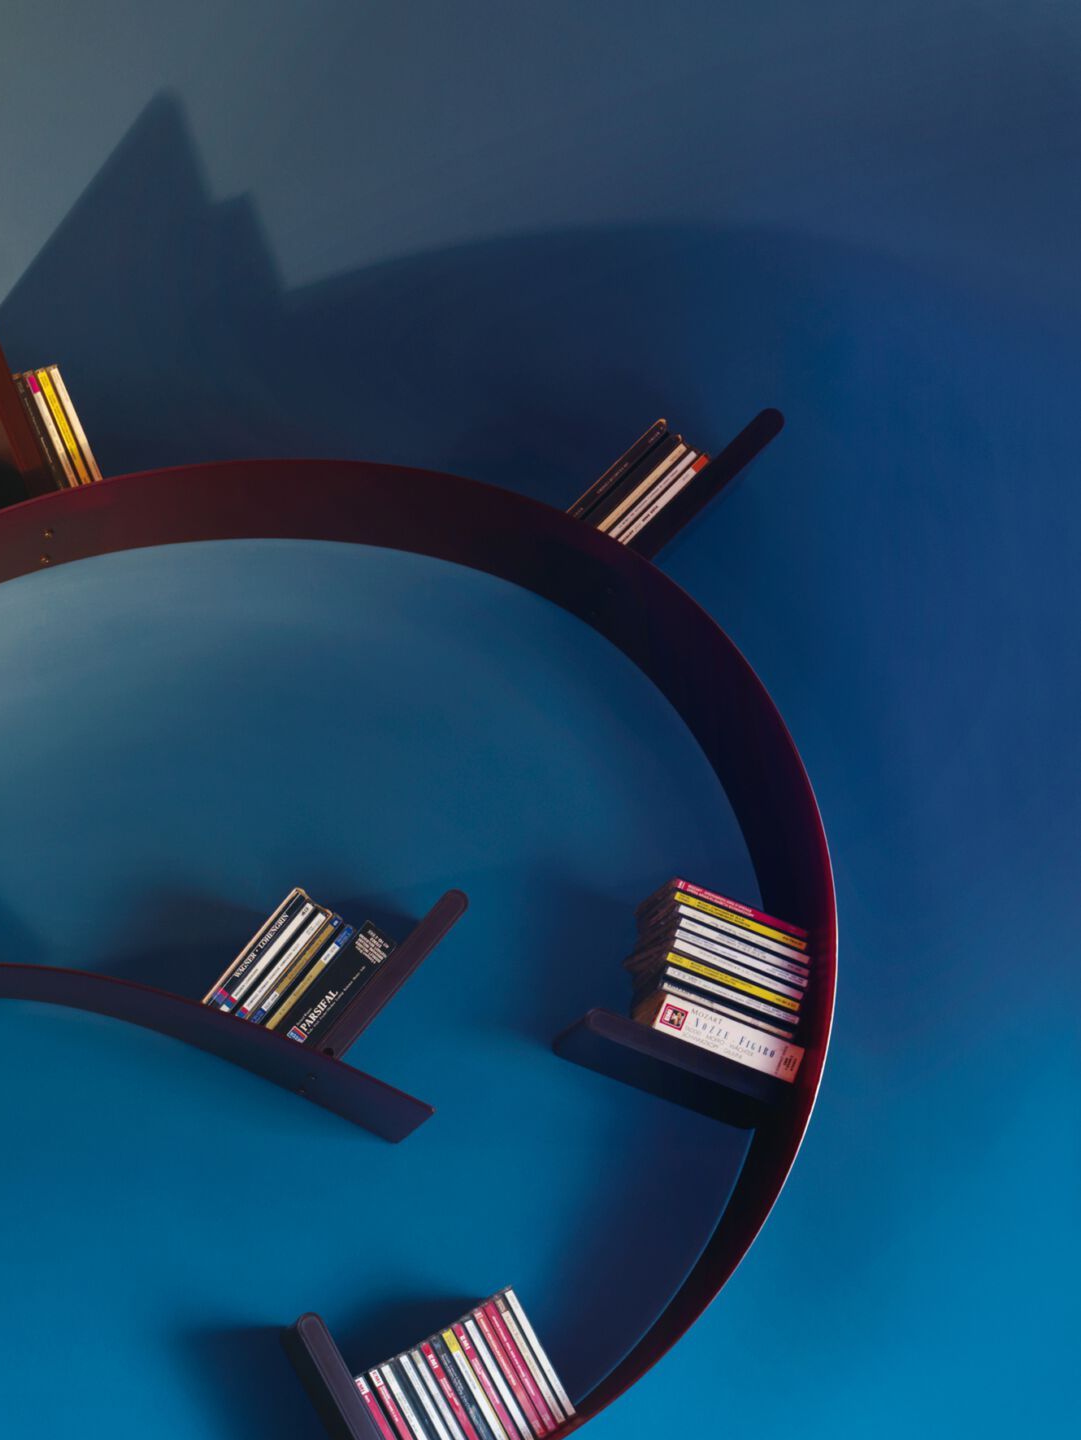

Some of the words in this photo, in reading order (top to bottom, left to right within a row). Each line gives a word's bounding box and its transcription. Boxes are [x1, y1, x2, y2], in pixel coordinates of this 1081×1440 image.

[233, 950, 258, 979] WAGNER
[257, 911, 289, 950] LOHENGRIN
[299, 986, 339, 1033] PARSIFAL
[690, 1008, 723, 1025] MOZART
[458, 1334, 471, 1350] EMI
[426, 1352, 439, 1369] EMI
